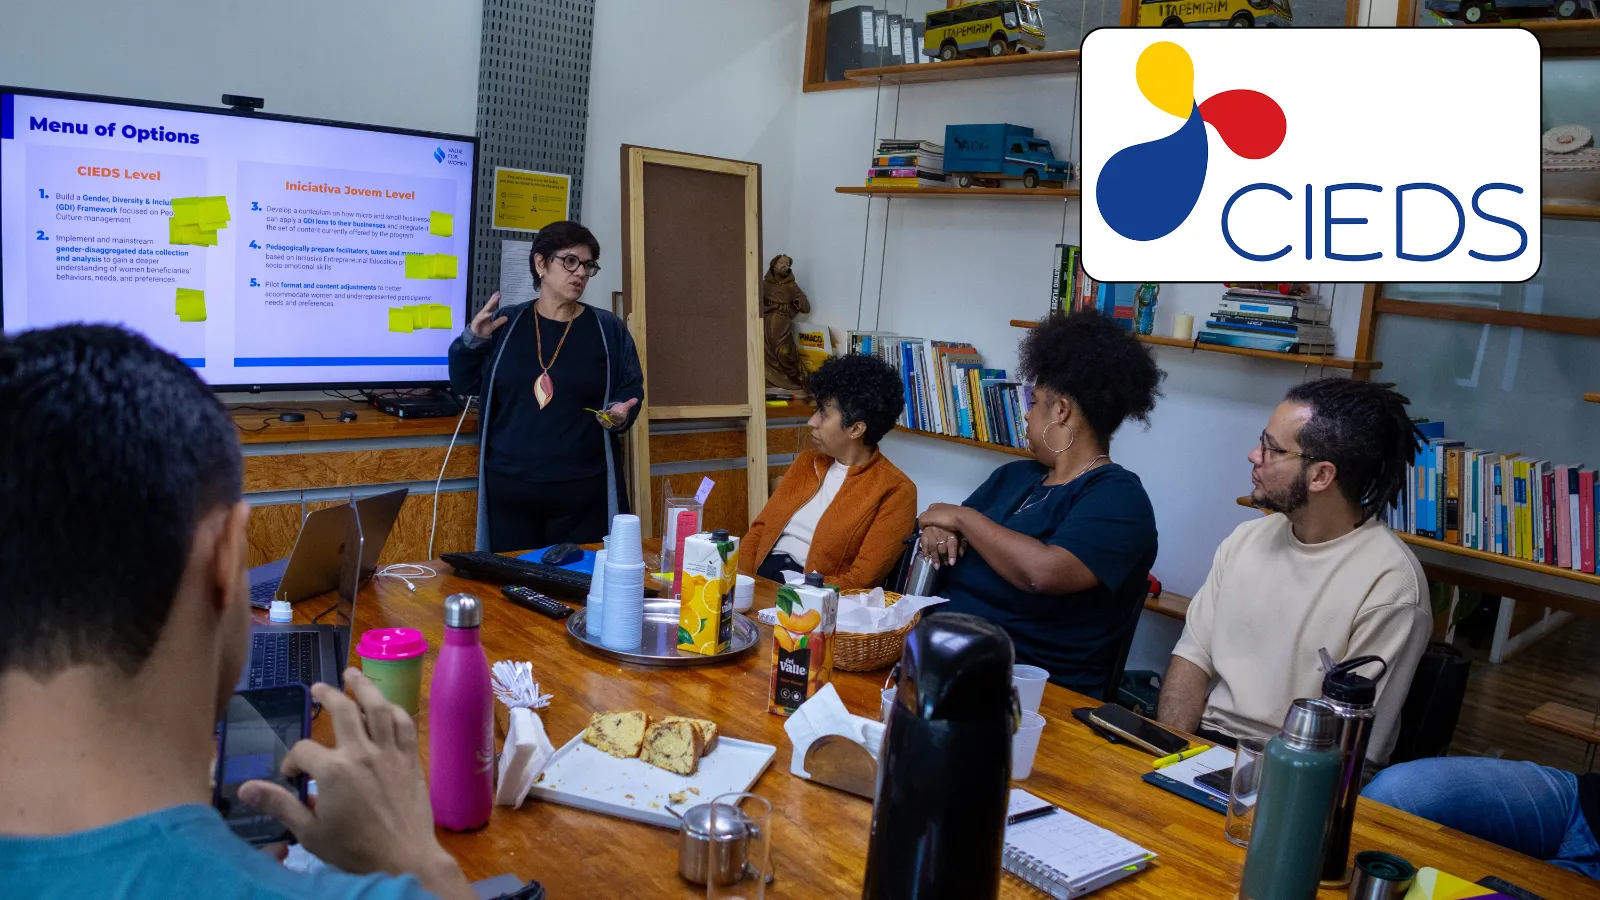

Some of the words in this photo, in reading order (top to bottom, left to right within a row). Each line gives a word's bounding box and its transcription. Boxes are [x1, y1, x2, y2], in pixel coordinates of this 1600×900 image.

[1159, 0, 1228, 17] ITAPEMIRIM
[944, 24, 992, 38] ITAPEMIRIM
[30, 116, 88, 136] Menu
[95, 122, 116, 137] of
[122, 124, 200, 144] Options
[77, 166, 120, 178] CIEDS
[124, 169, 161, 181] Level
[38, 188, 50, 199] 1.
[285, 180, 341, 195] Iniciativa
[344, 185, 382, 198] Jovem
[385, 188, 415, 200] Level
[56, 192, 74, 201] Build
[82, 194, 110, 203] Gender,
[112, 196, 144, 206] Diversity
[56, 204, 75, 213] (GDI)
[77, 205, 118, 214] Framework
[119, 207, 148, 215] focused
[251, 202, 262, 212] 3.
[266, 206, 292, 215] Develop
[402, 214, 430, 222] businesse
[321, 227, 347, 236] currently
[399, 223, 425, 232] integrate
[36, 230, 50, 241] 2.
[56, 235, 95, 243] Implement
[249, 240, 261, 250] 4.
[266, 244, 310, 253] Pedagogically
[311, 246, 334, 255] prepare
[336, 246, 370, 256] facilitators,
[56, 246, 137, 256] gender-disaggregated
[72, 255, 102, 263] analysis
[112, 256, 128, 265] gain
[136, 257, 159, 266] deeper
[323, 256, 368, 265] Entrepreneurial
[369, 258, 398, 266] Education
[56, 264, 108, 274] understanding
[56, 274, 93, 282] behaviors,
[135, 275, 177, 283] preferences.
[250, 278, 261, 287] 5.
[340, 283, 376, 291] adjustments
[346, 293, 396, 302] underrepresented
